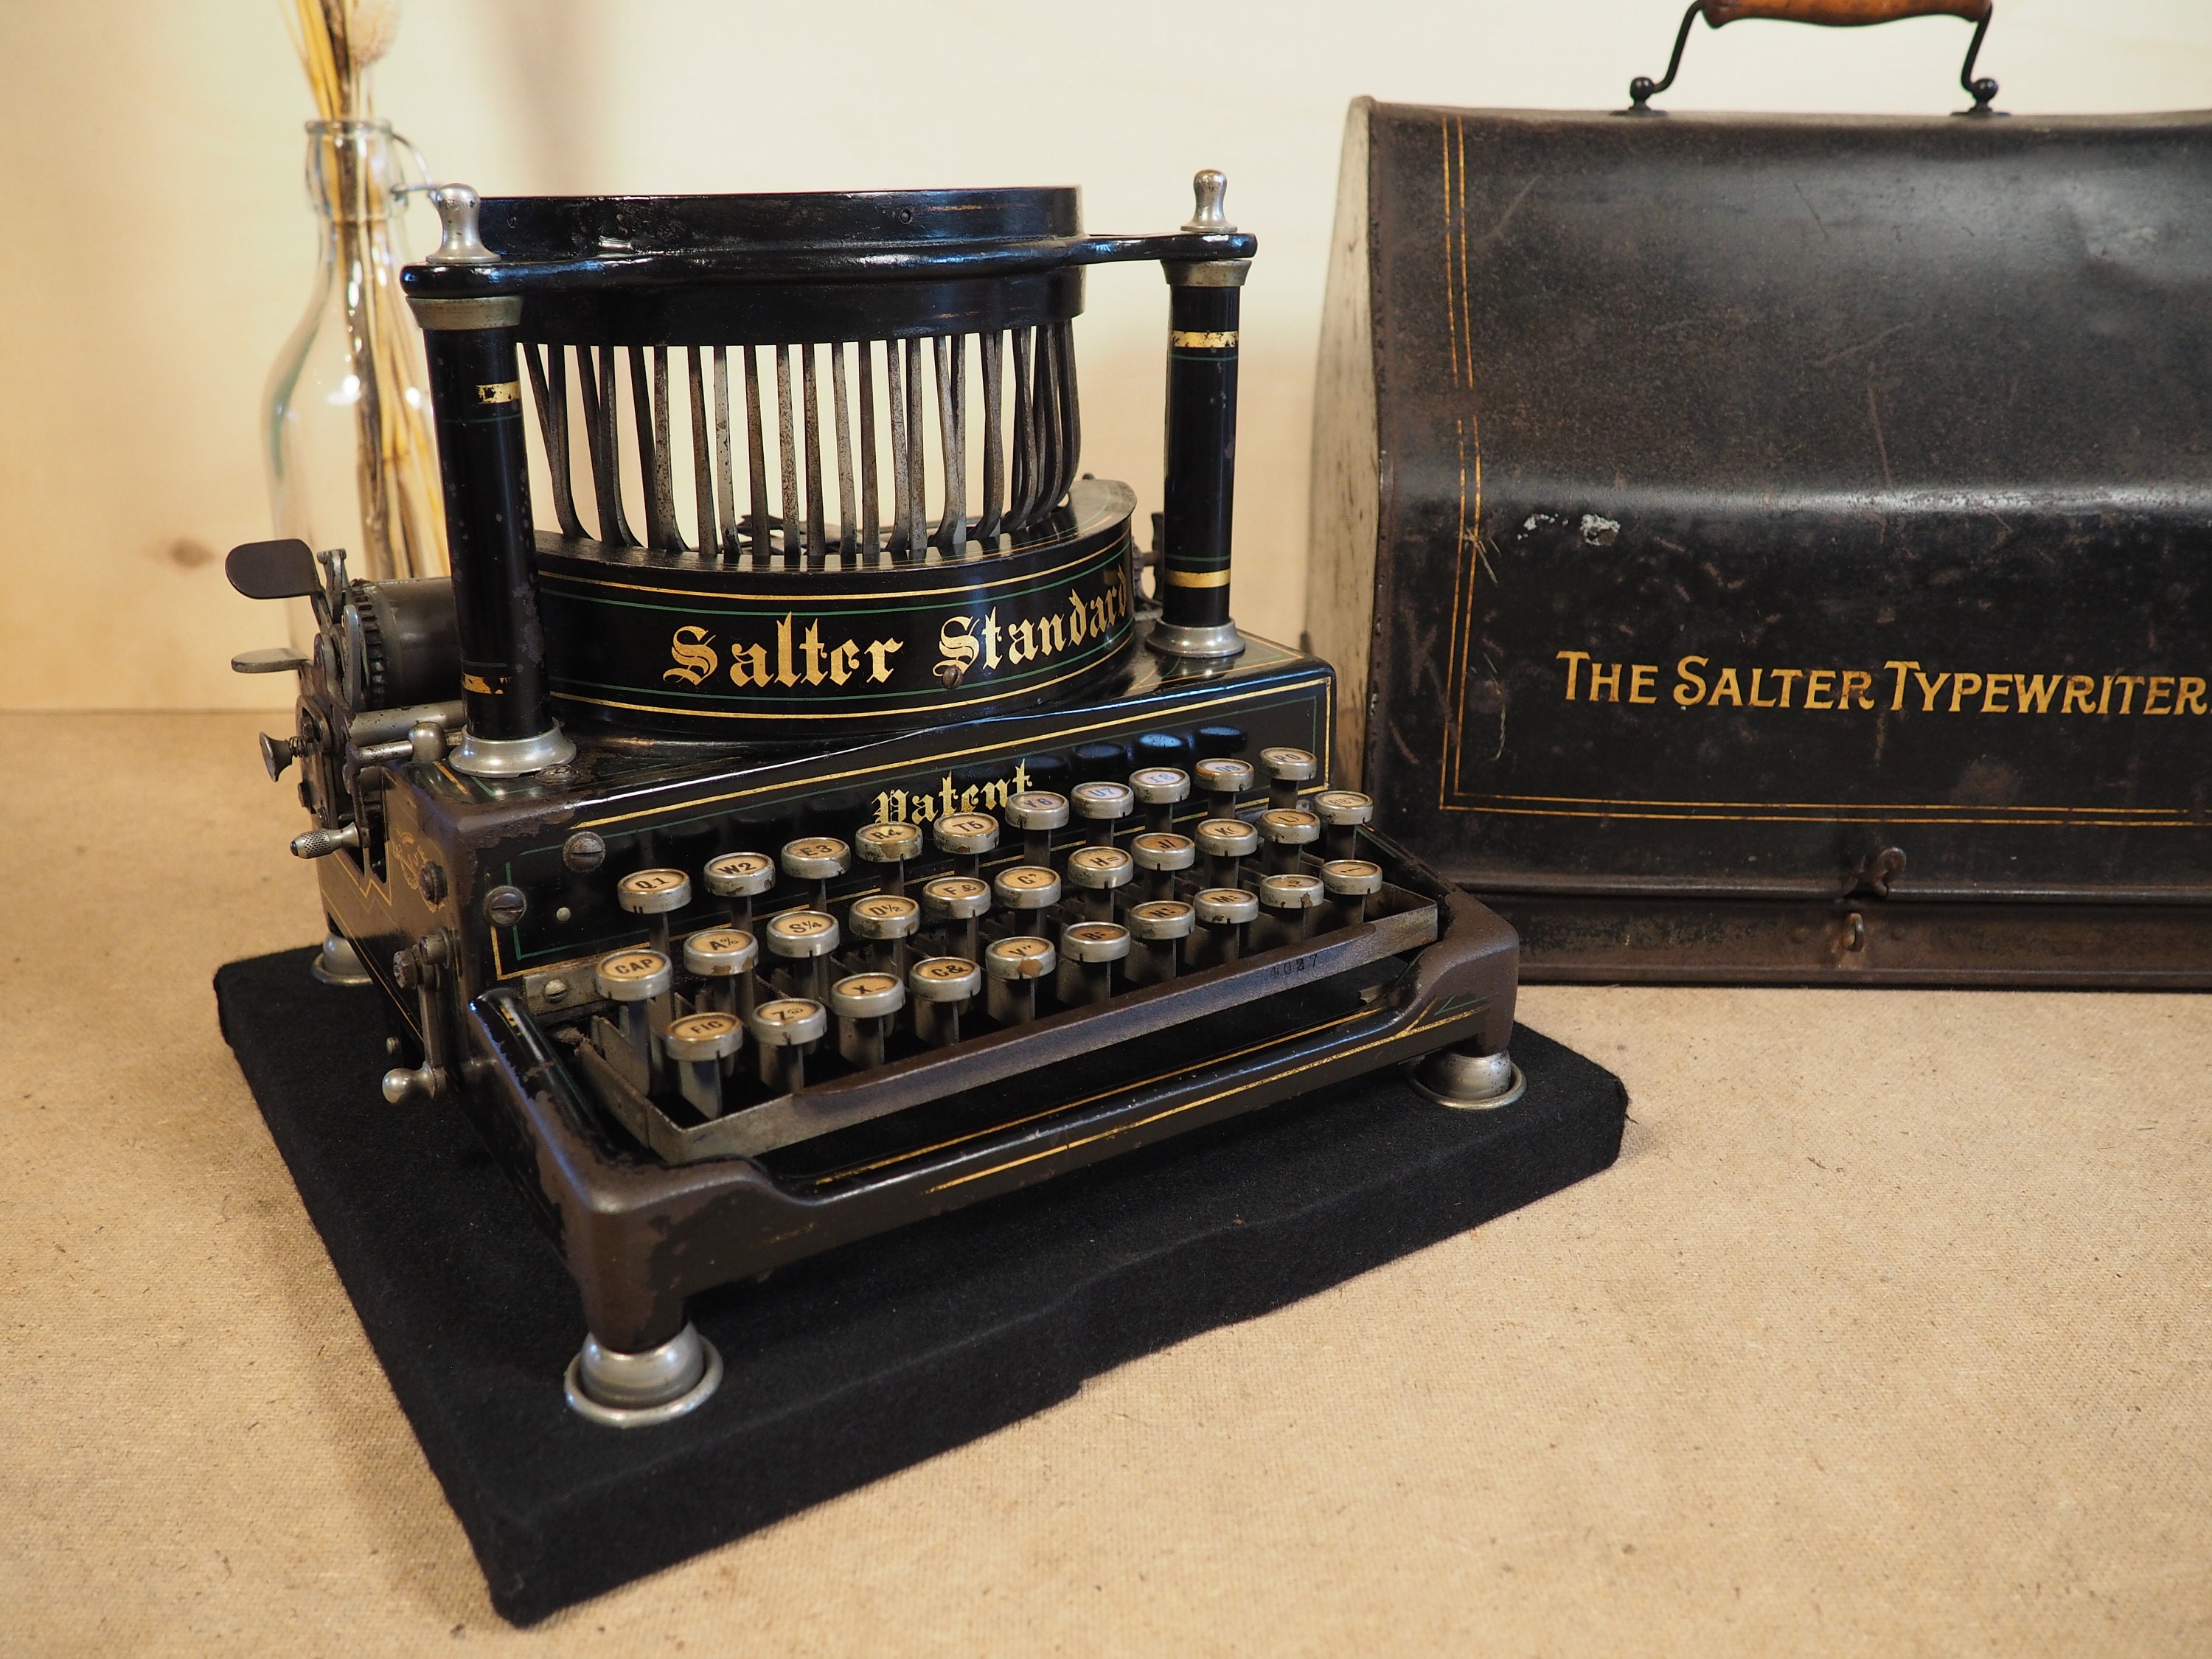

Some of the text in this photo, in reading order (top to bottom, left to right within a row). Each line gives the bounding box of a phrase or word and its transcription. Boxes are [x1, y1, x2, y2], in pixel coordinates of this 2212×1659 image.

[663, 564, 1128, 687] Salter Standard
[1556, 650, 1659, 704] THE
[1673, 655, 1874, 709] SALTER
[871, 759, 1033, 825] Patent
[614, 959, 654, 974] CAP
[689, 1020, 724, 1034] FIG
